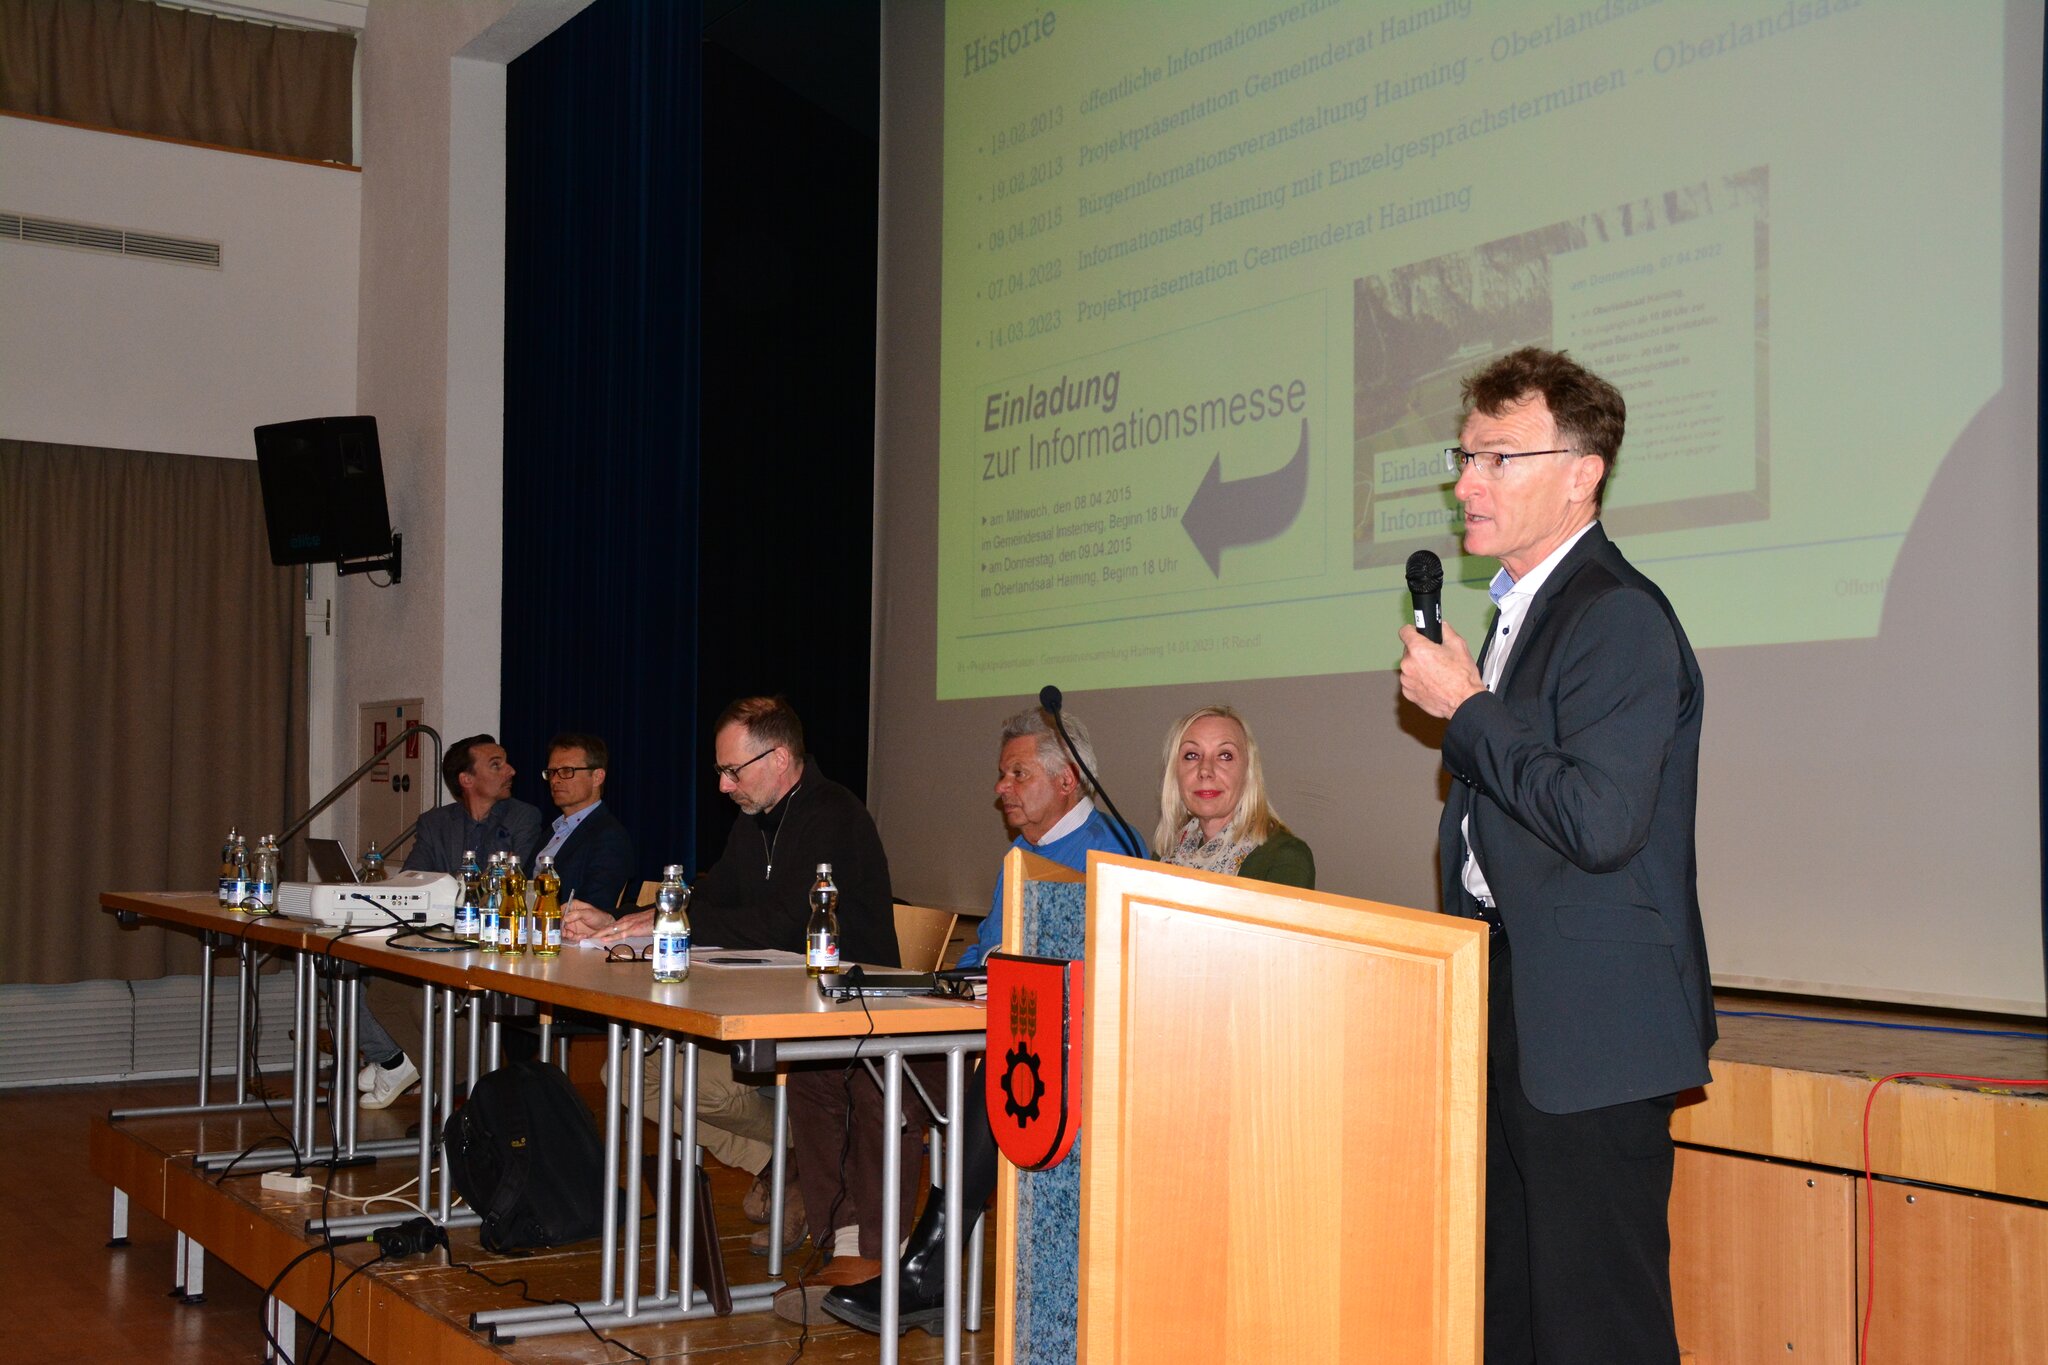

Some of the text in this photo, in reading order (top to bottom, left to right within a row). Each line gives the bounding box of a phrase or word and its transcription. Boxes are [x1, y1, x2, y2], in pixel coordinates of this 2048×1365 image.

[962, 8, 1057, 78] Historie
[991, 0, 1472, 204] 19.02.2013 Projektpräsentation Gemeinderat Haiming
[991, 106, 1064, 155] 19.02.2013
[987, 258, 1062, 301] 07.04.2022
[1077, 213, 1204, 271] Informationstag
[1209, 183, 1286, 226] Haiming
[1291, 171, 1322, 199] mit
[1328, 67, 1626, 186] Einzelgesprächsterminen
[988, 206, 1063, 251] 09.04.2015
[1077, 94, 1367, 219] Bürgerinformationsveranstaltung
[1374, 57, 1467, 110] Haiming
[987, 184, 1472, 350] 14.03.2023 Projektpräsentation Gemeinderat Haiming
[982, 378, 1307, 481] zur Informationsmesse
[983, 370, 1121, 432] Einladung
[981, 538, 992, 551] im
[993, 528, 1054, 549] Gemeindesaal
[1109, 512, 1142, 529] Beginn
[1147, 506, 1158, 522] 18
[1161, 504, 1179, 520] Uhr
[990, 514, 1003, 526] am
[1053, 501, 1071, 514] den
[980, 585, 991, 598] im
[993, 575, 1054, 597] Oberlandsaal
[1103, 564, 1138, 583] Beginn
[1142, 559, 1155, 575] 18
[1158, 557, 1179, 573] Uhr
[989, 561, 1002, 573] am
[1059, 549, 1076, 562] den
[1078, 537, 1132, 559] 09.04.2015
